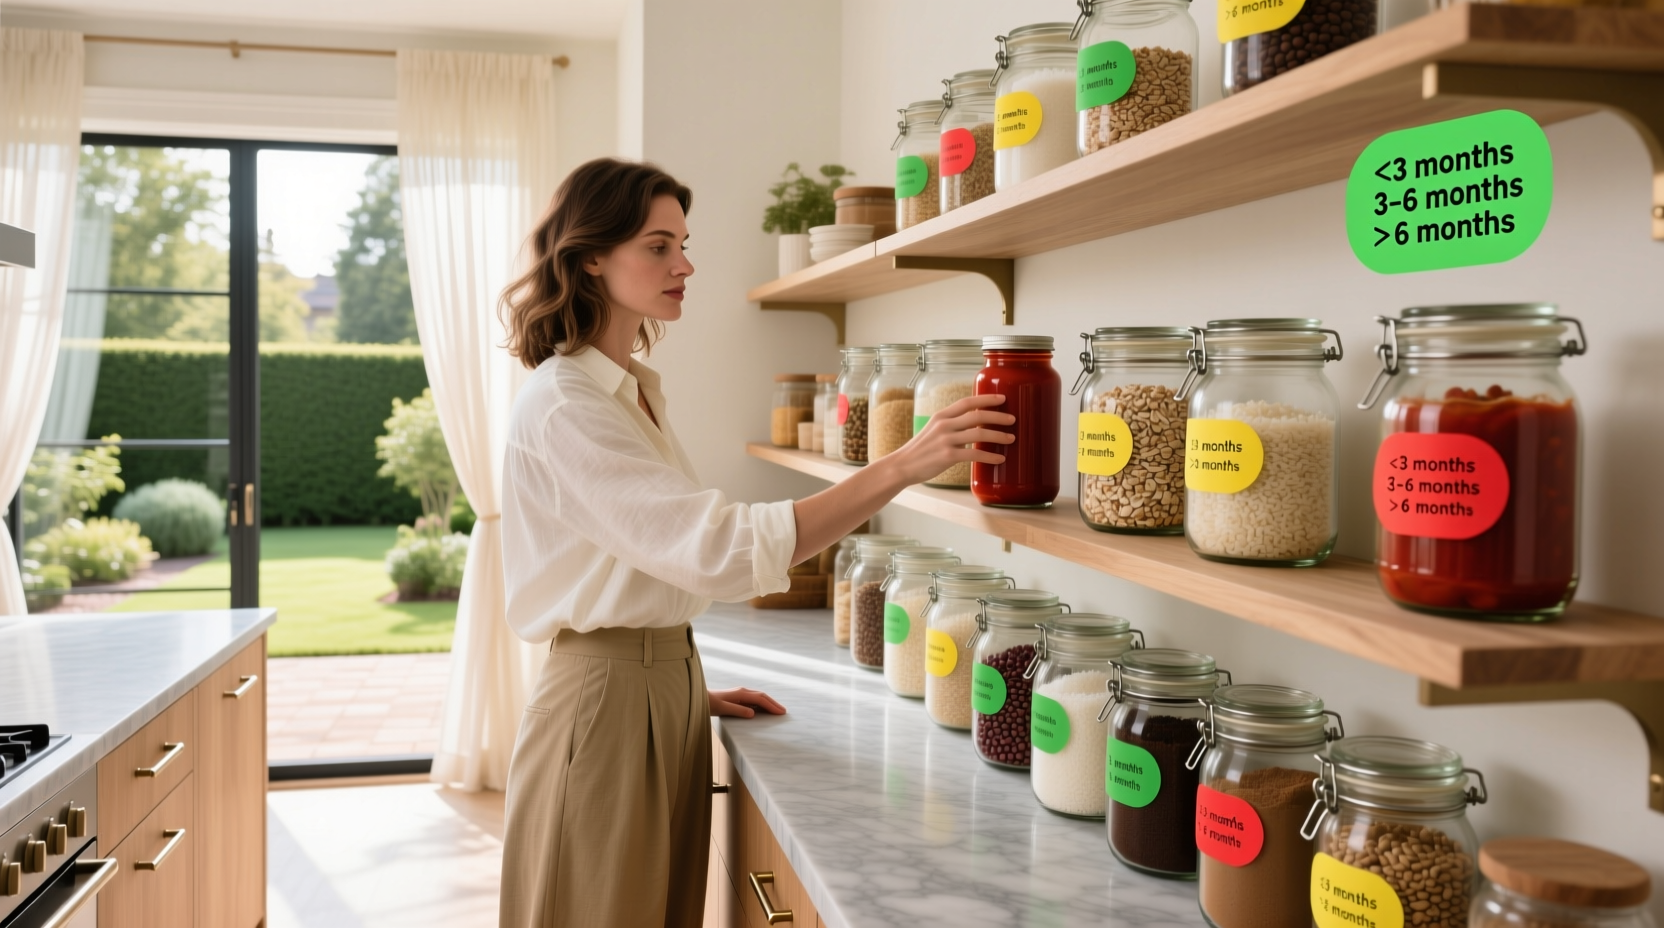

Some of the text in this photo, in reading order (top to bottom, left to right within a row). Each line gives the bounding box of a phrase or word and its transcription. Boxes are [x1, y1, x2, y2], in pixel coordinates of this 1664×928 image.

[1202, 439, 1243, 453] months
[1202, 459, 1240, 472] months
[1389, 455, 1476, 473] <3 months
[1387, 476, 1480, 495] 3-6 months
[1389, 498, 1474, 517] >6 months
[1333, 886, 1378, 910] months
